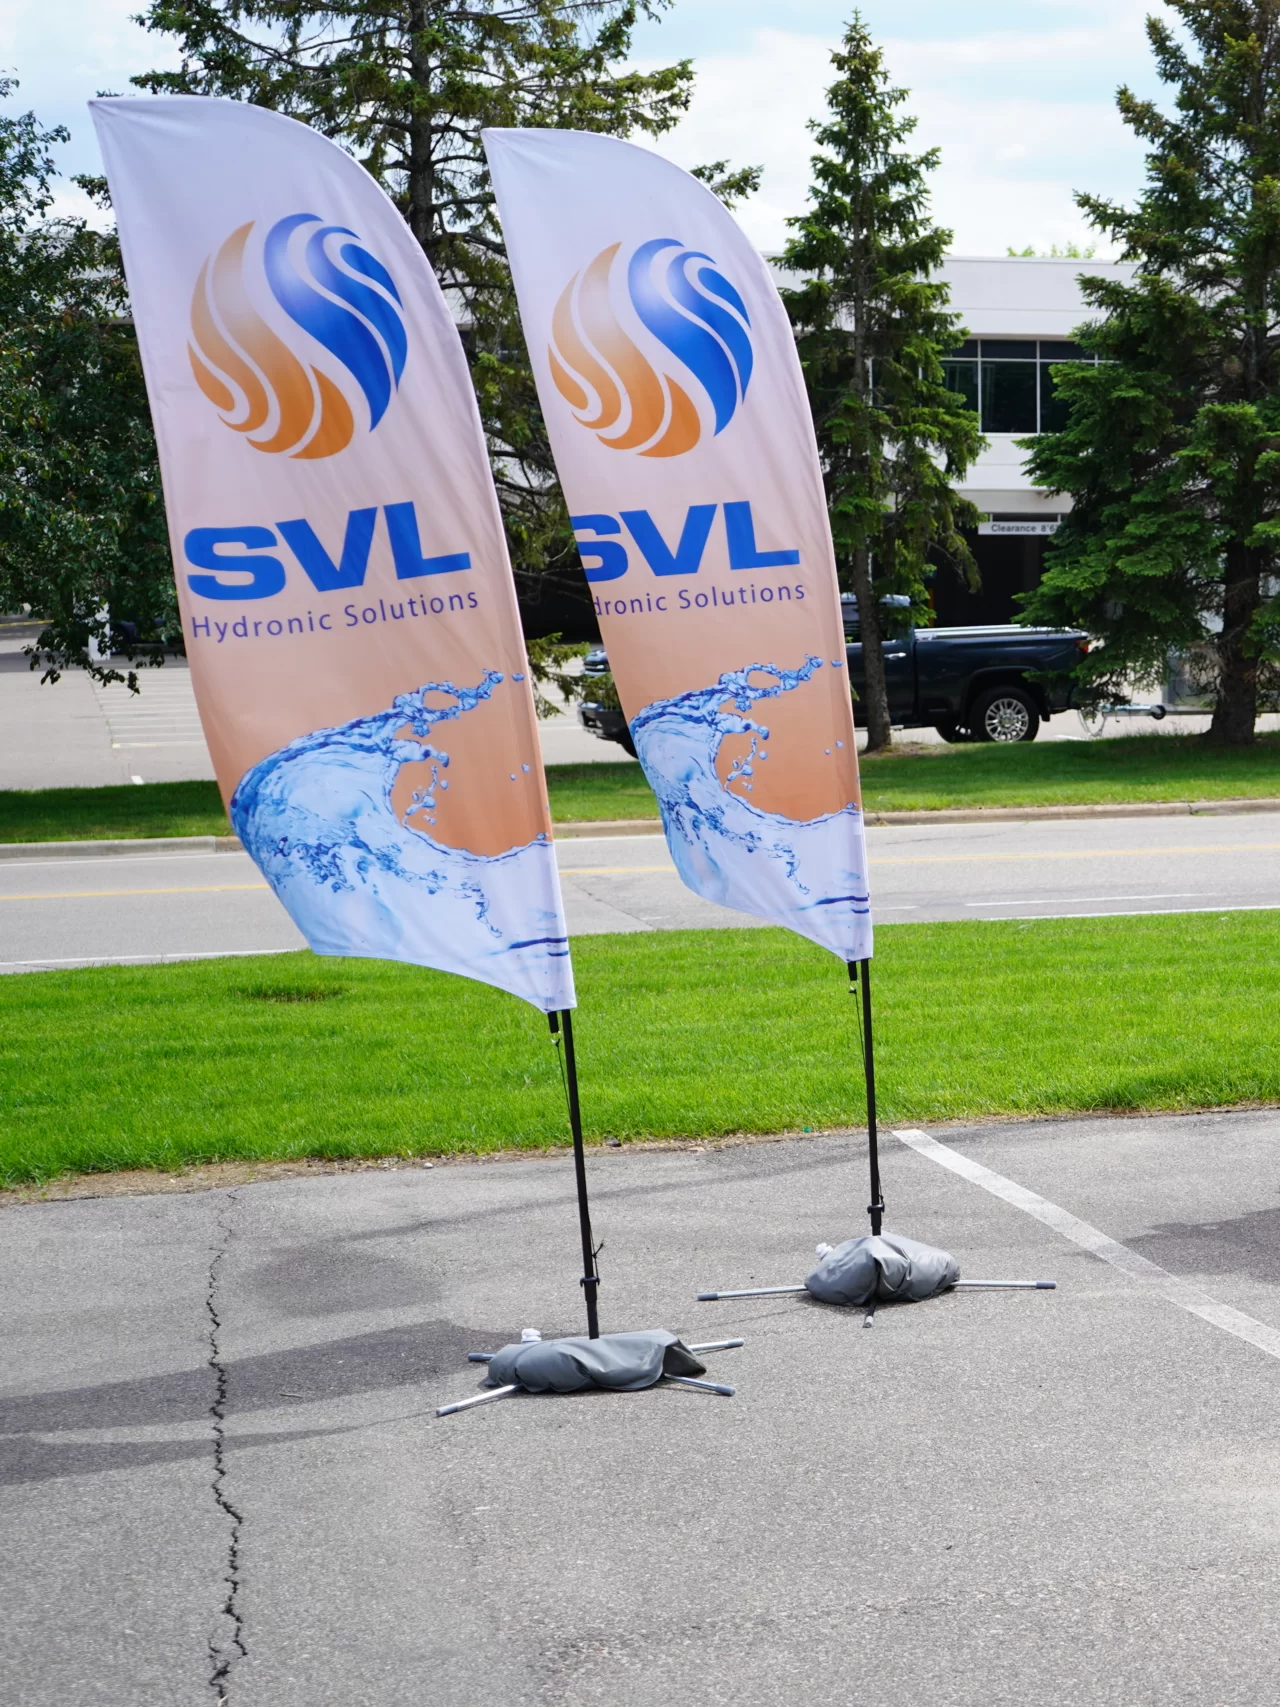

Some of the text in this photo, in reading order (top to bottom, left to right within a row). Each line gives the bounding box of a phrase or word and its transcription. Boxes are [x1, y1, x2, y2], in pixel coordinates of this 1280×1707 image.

[184, 501, 471, 600] SVL
[569, 501, 800, 582] SVL
[991, 524, 1036, 532] Clearance
[191, 591, 479, 643] Hydronic Solutions
[678, 584, 805, 610] Solutions
